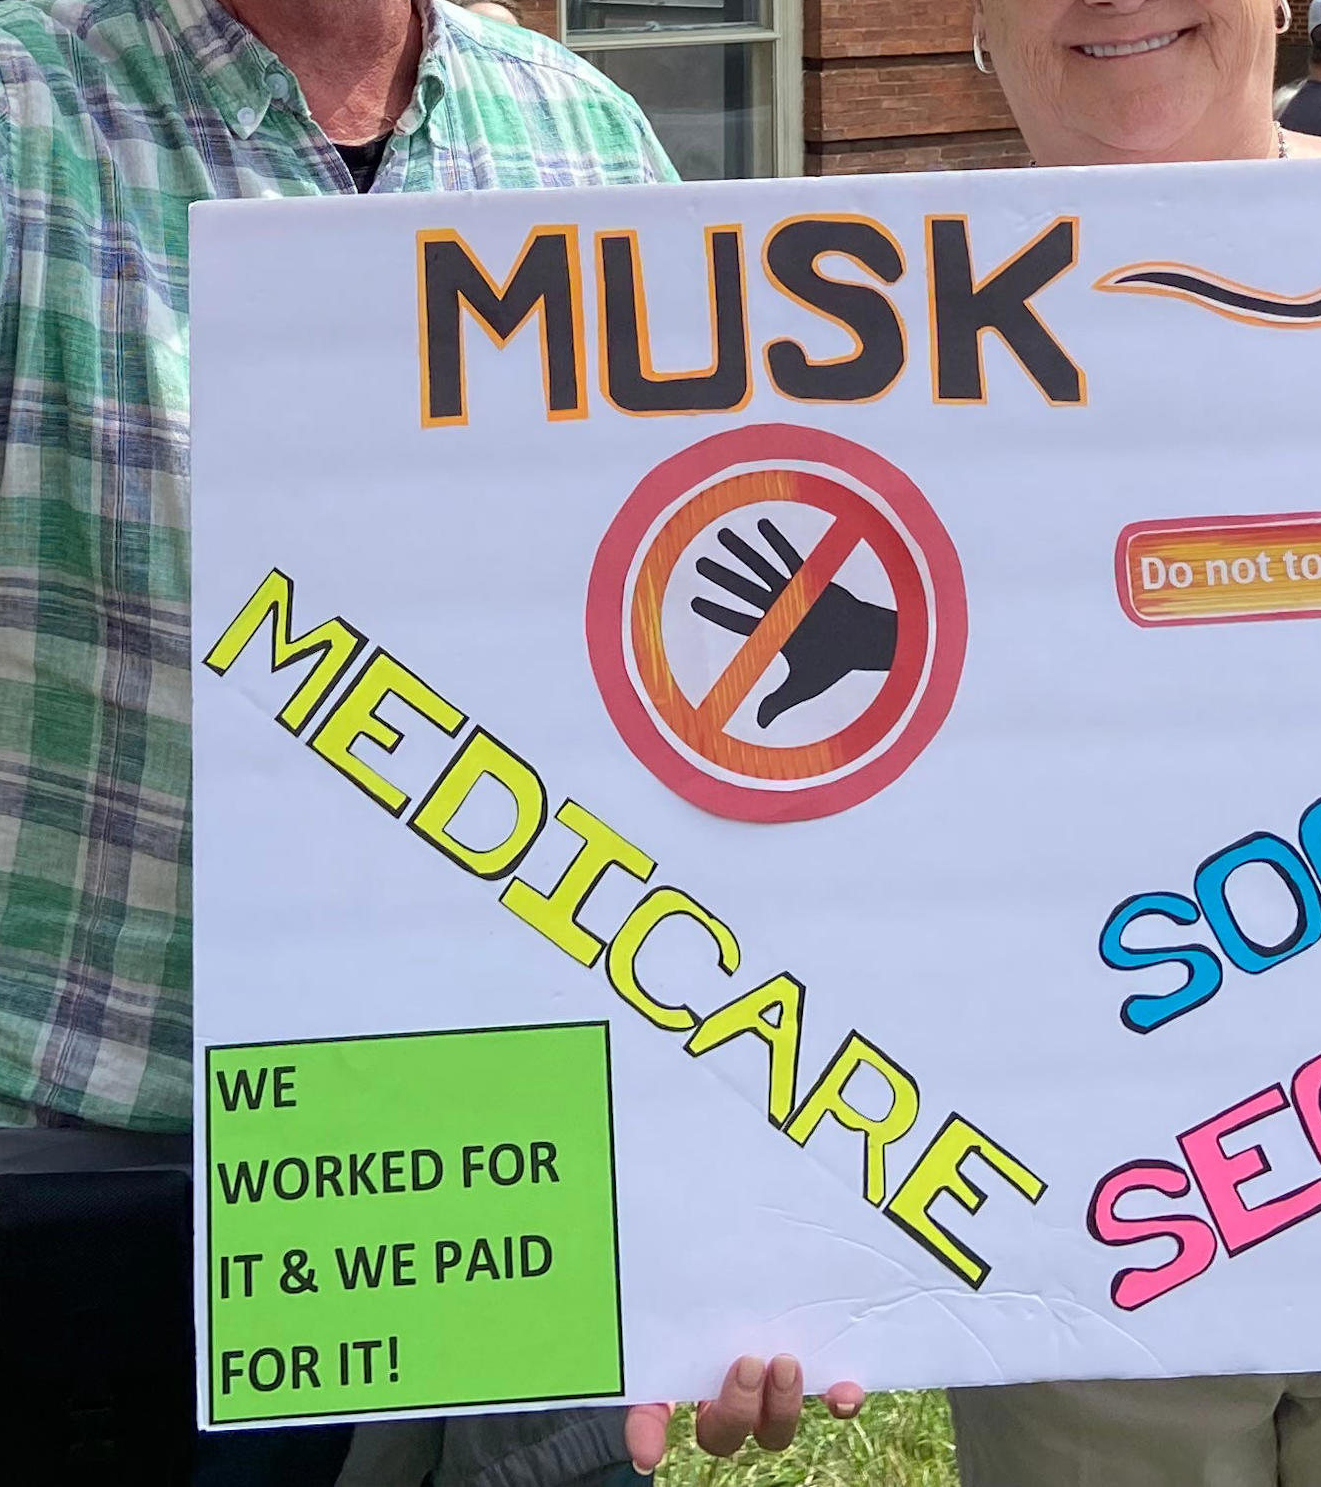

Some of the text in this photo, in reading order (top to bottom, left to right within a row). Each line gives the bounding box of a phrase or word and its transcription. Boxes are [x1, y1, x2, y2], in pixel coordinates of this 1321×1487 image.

[416, 211, 1088, 430] MUSK
[1140, 556, 1194, 590] Do
[1206, 550, 1274, 586] not
[202, 568, 1049, 1291] MEDICARE
[216, 1065, 297, 1112] WE
[217, 1141, 560, 1205] WORKED FOR
[220, 1234, 553, 1299] IT & WE PAID
[221, 1336, 400, 1395] FOR IT!
